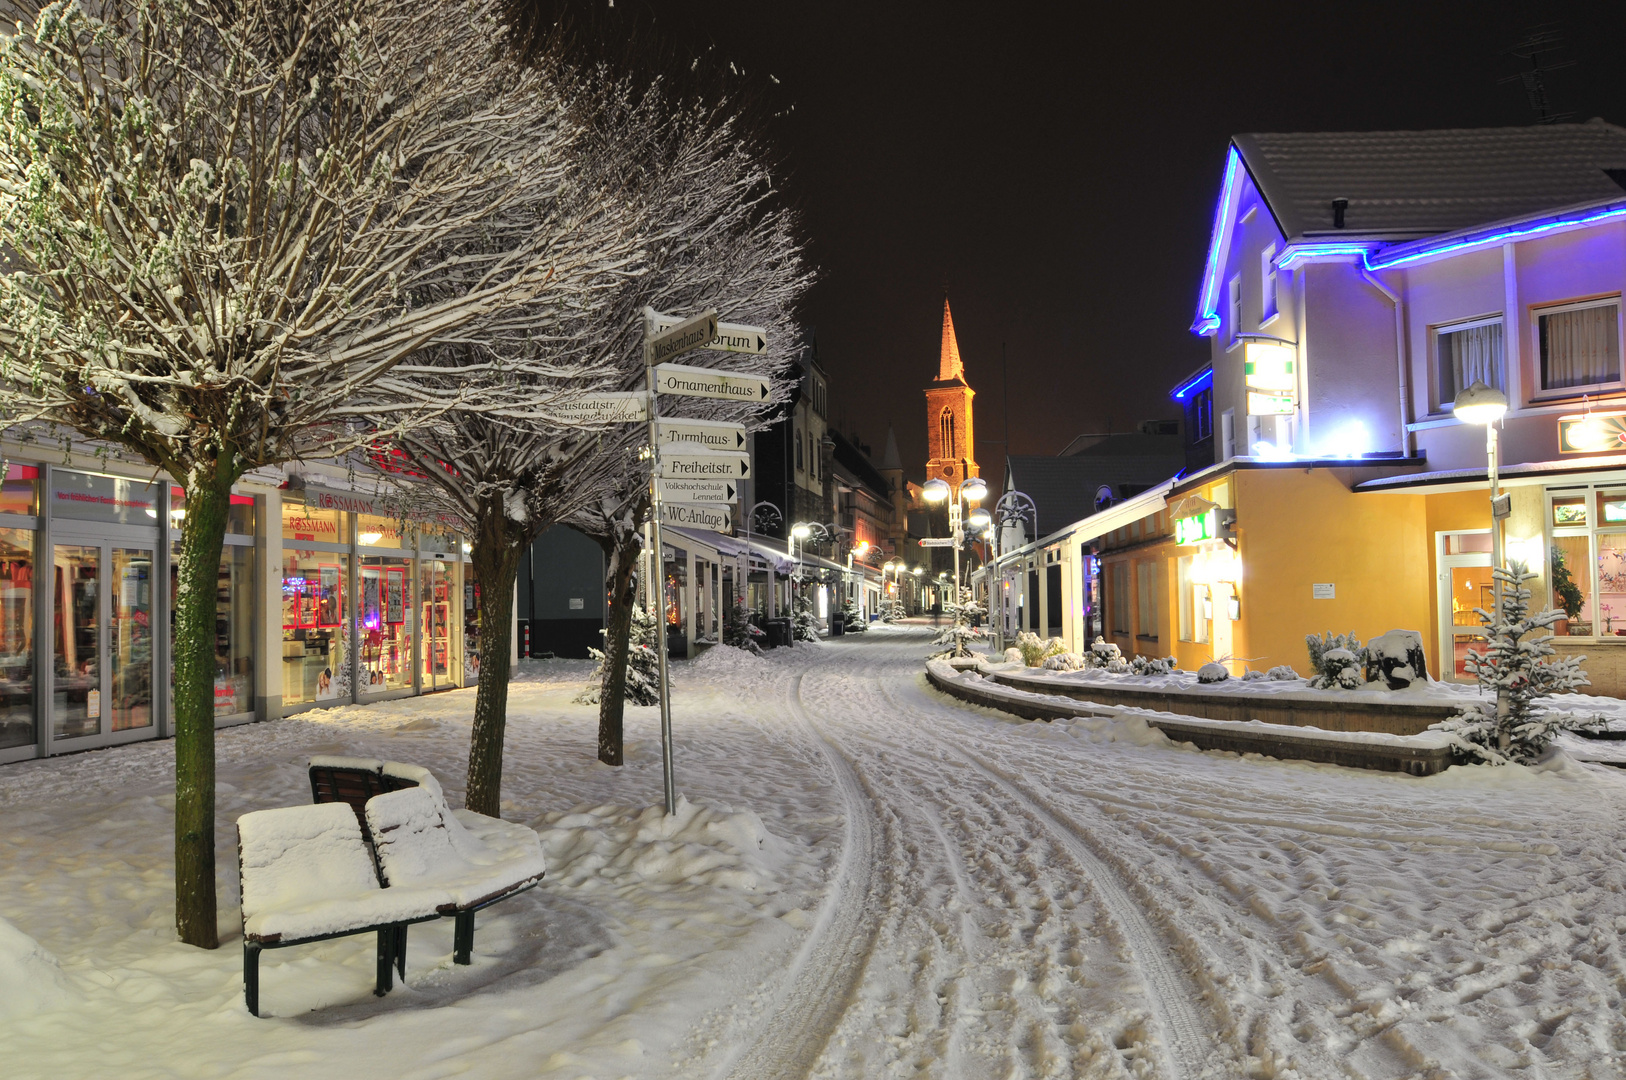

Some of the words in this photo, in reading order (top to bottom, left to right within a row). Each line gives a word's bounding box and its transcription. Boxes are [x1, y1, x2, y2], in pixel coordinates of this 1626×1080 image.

[655, 328, 704, 360] Maskenhaus
[672, 461, 733, 474] Freiheitstr.
[665, 482, 723, 491] Volkshochschule
[319, 493, 373, 513] ROSSMANN
[693, 493, 724, 501] Lennetal
[289, 516, 336, 534] ROSSMANN
[668, 506, 722, 529] WC-Anlage
